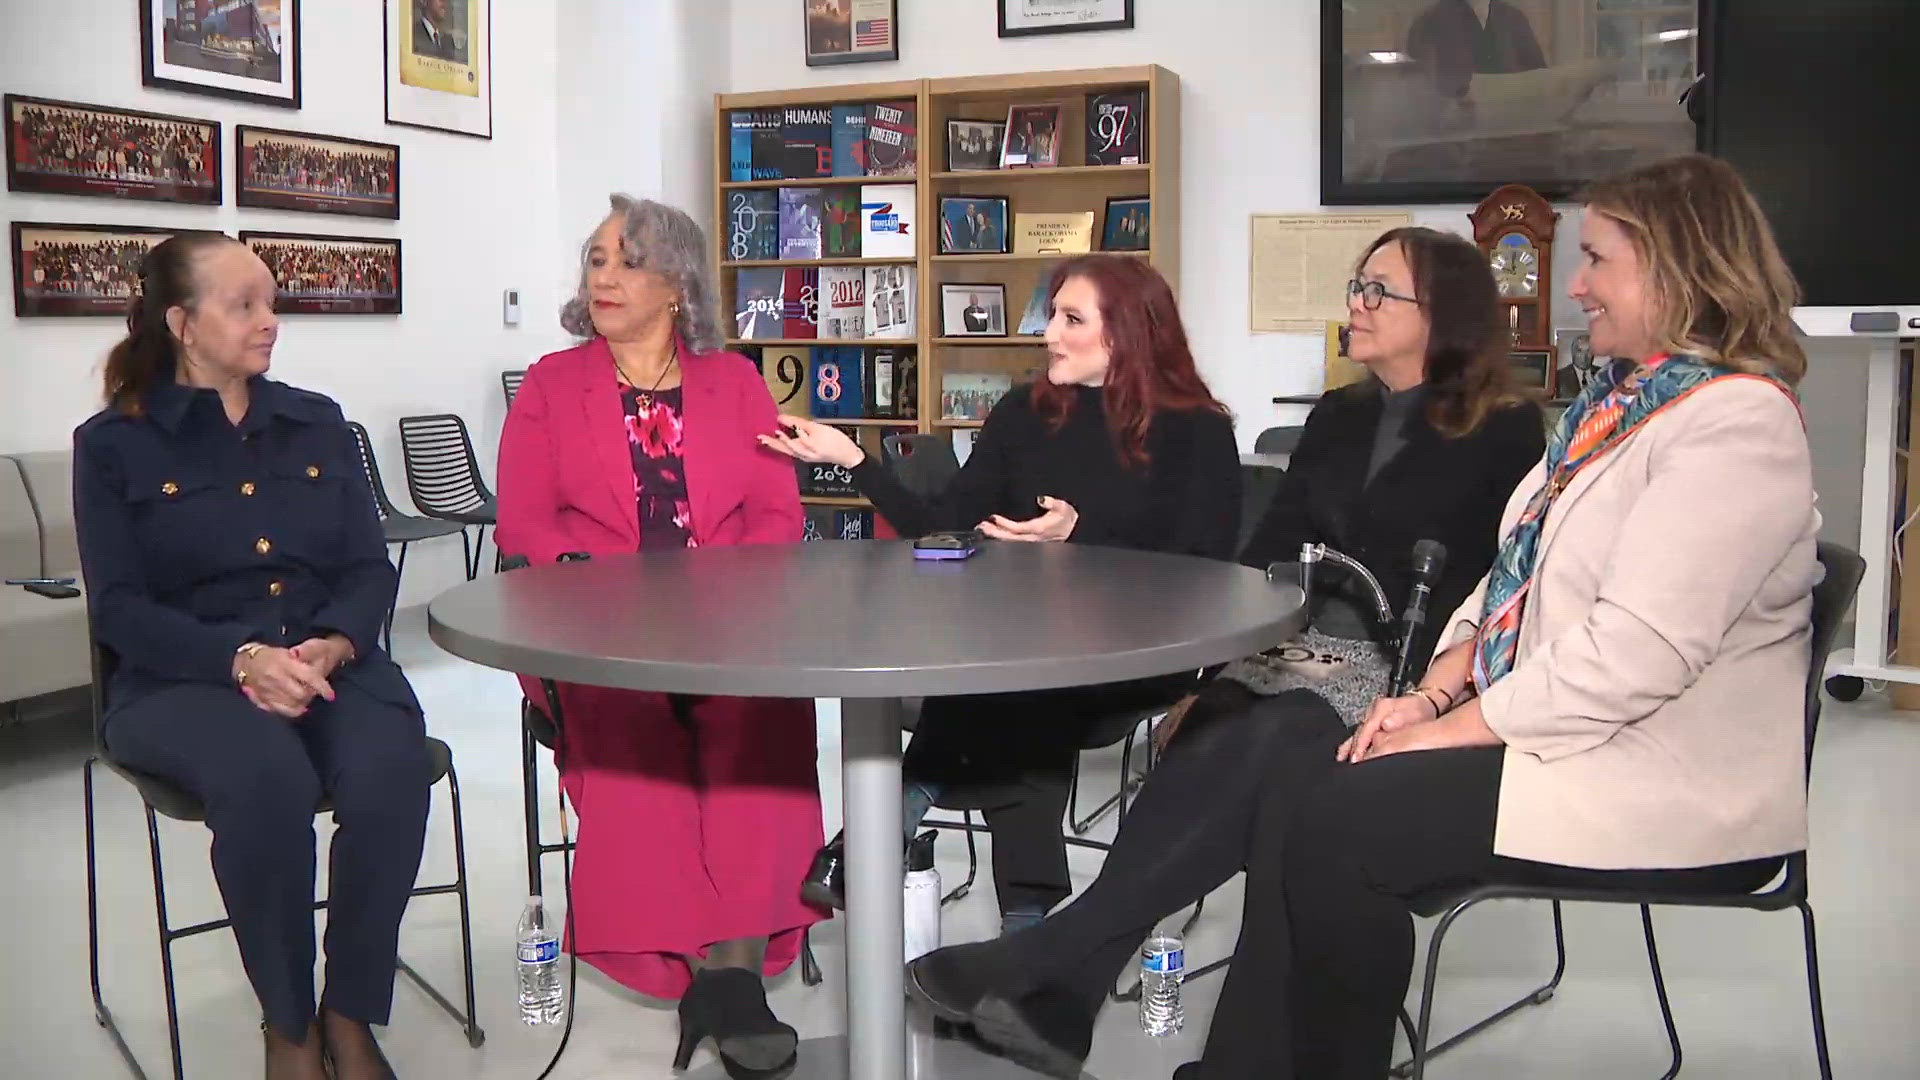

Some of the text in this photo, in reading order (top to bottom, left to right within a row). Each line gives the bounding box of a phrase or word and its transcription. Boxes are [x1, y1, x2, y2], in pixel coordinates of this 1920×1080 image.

[784, 109, 832, 125] HUMANS
[875, 105, 903, 124] TWENTY
[869, 126, 902, 146] NINETEEN
[1098, 104, 1128, 152] 97
[830, 279, 863, 303] 2012
[747, 298, 784, 312] 2014
[777, 355, 803, 405] 9
[817, 364, 841, 402] 8
